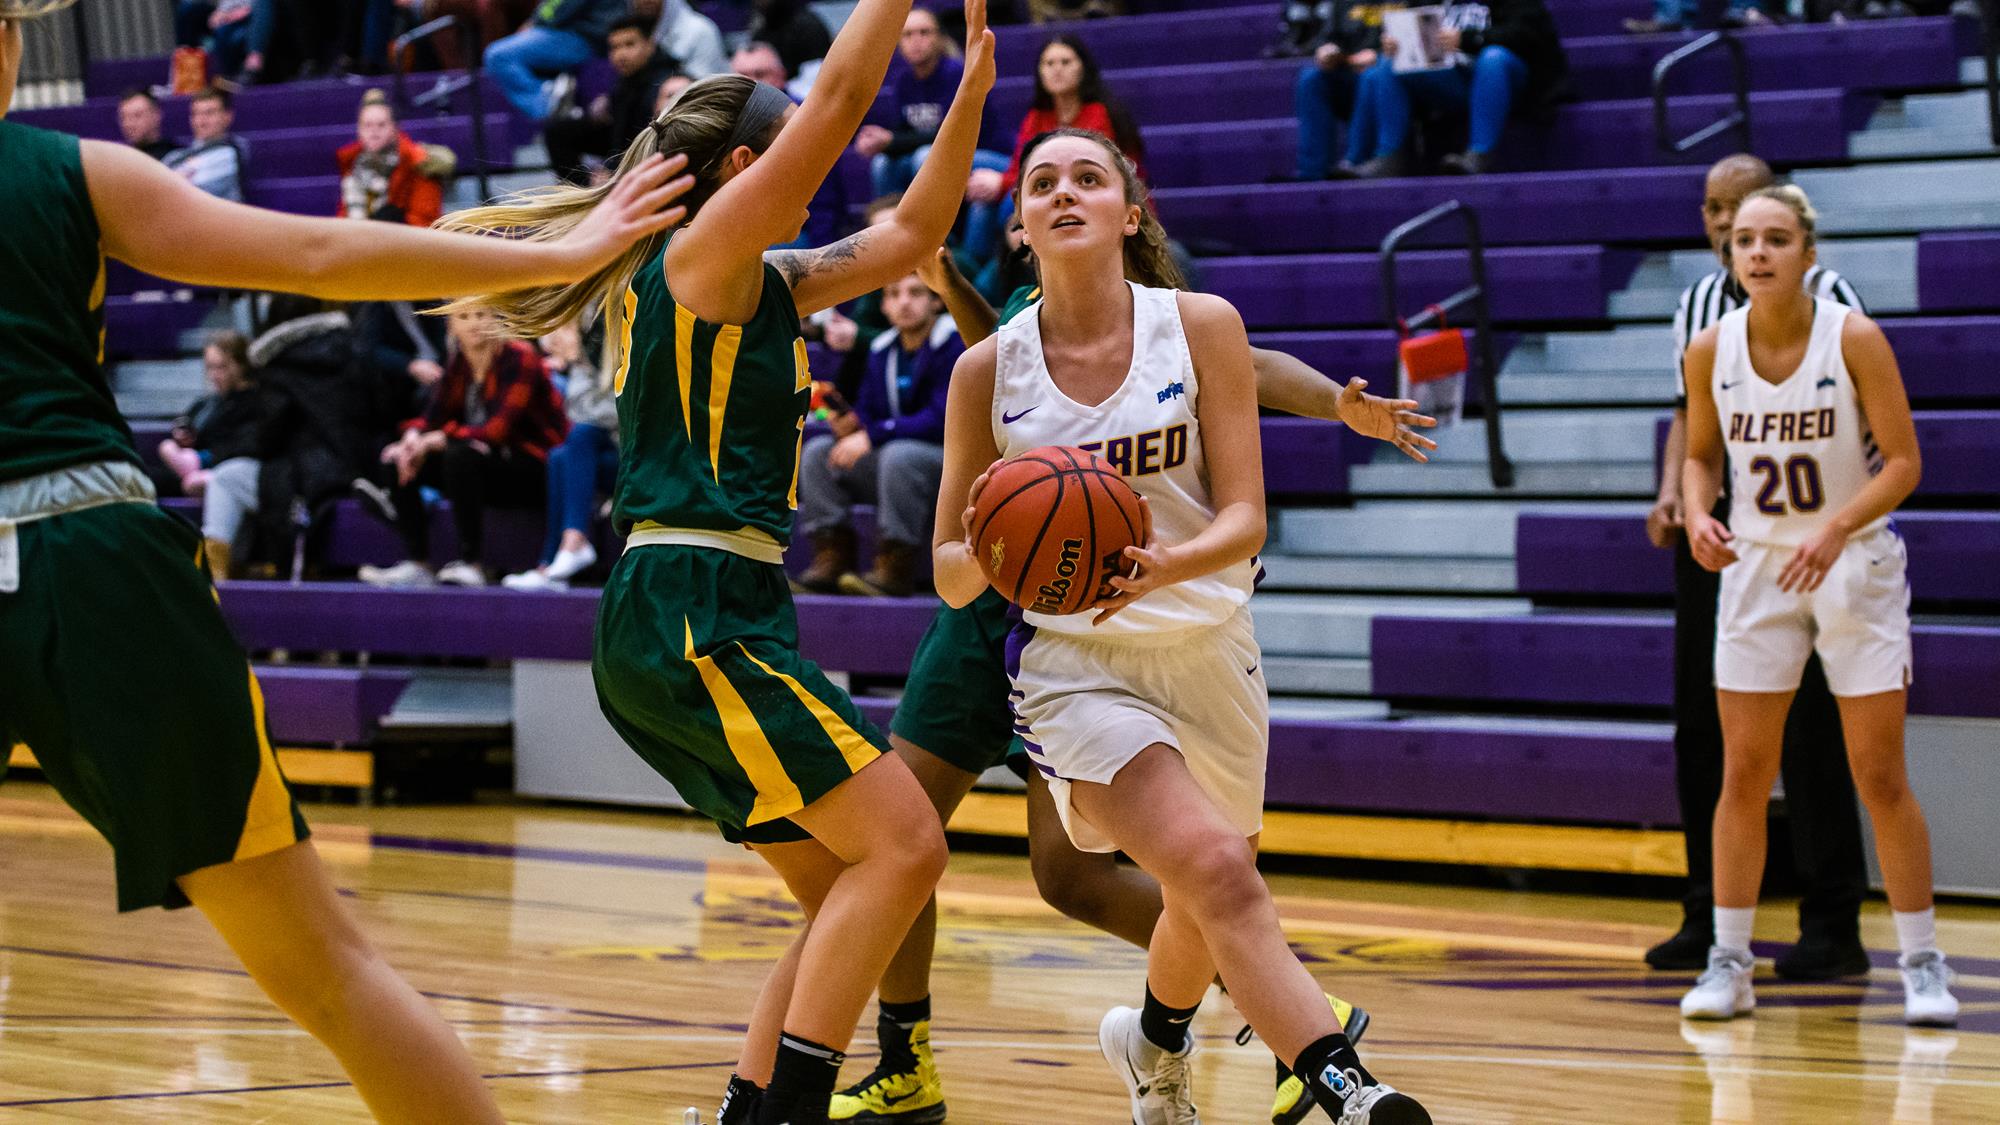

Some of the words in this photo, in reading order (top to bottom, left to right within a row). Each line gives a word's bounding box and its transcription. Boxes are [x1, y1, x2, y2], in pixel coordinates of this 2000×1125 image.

[1077, 422, 1188, 477] RED
[1729, 408, 1836, 443] ALFRED
[1751, 453, 1825, 515] 20
